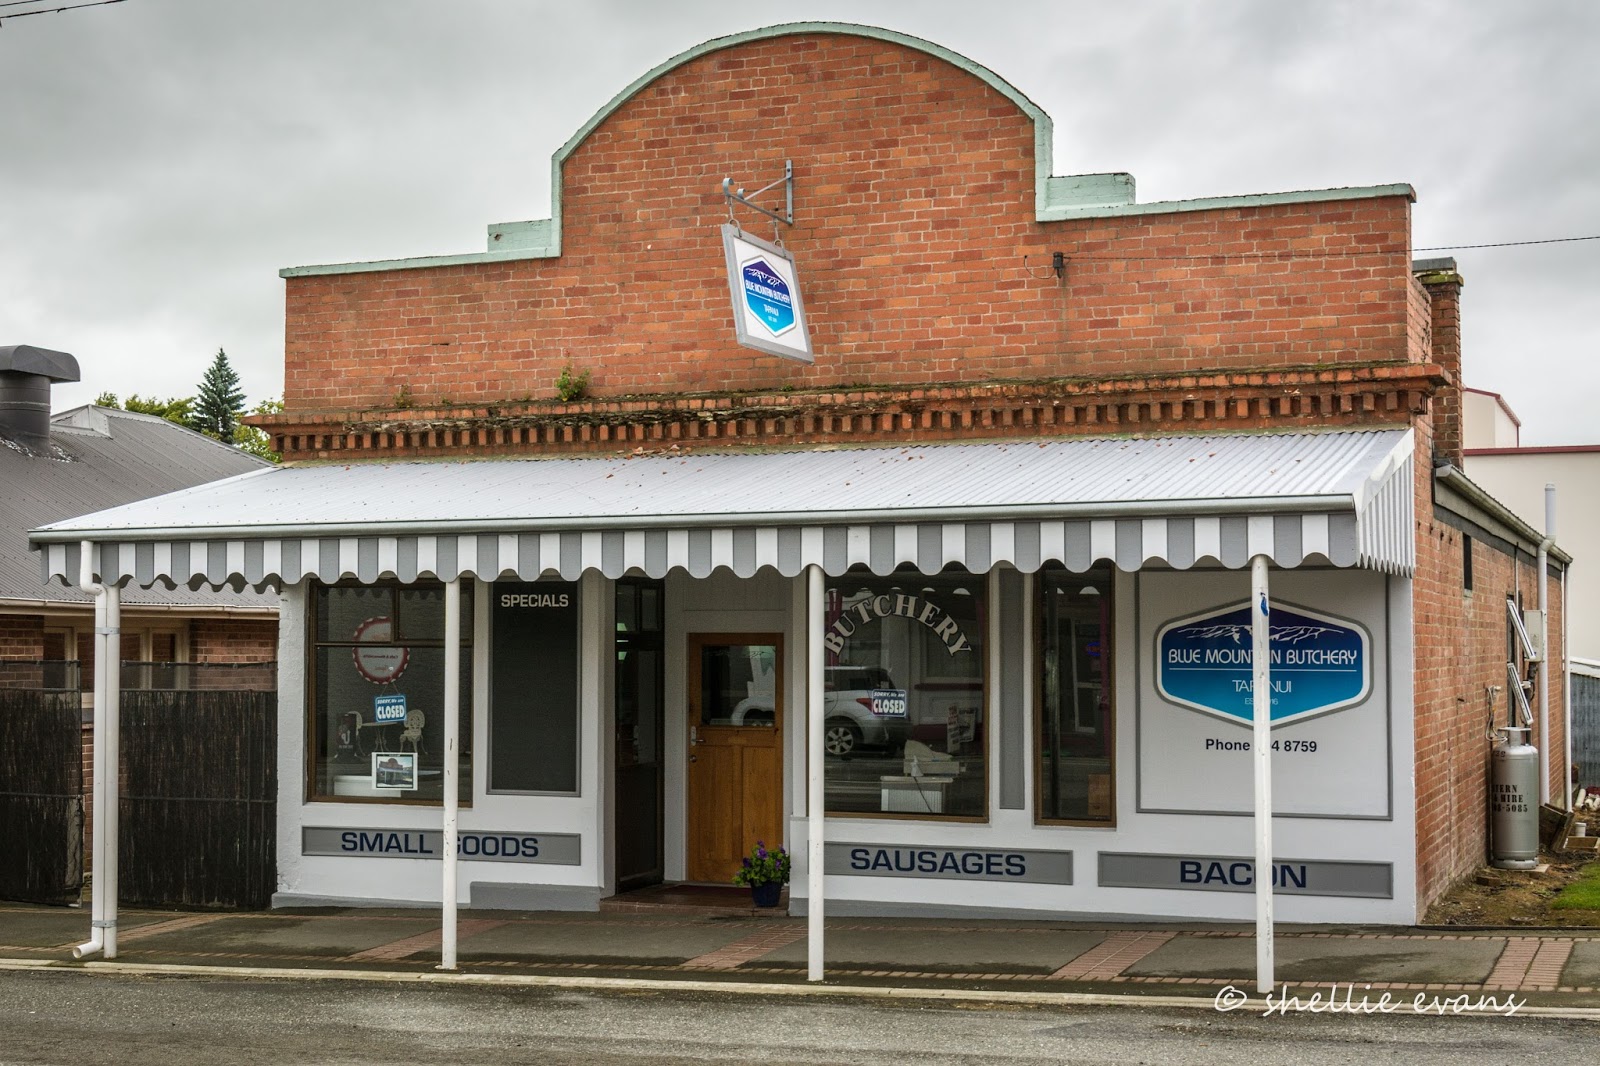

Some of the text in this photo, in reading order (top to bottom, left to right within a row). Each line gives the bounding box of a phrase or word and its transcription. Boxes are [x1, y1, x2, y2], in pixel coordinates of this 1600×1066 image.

[501, 594, 569, 607] SPECIALS
[824, 594, 972, 657] BUTCHERY
[1168, 649, 1357, 665] BLUE MOUNN BUTCHERY
[377, 704, 405, 719] CLOSED
[873, 699, 905, 713] CLOSED
[1205, 738, 1251, 751] Phone
[1284, 740, 1317, 752] 8759
[1500, 794, 1523, 803] HIRE
[341, 832, 539, 857] SMALL OODS
[850, 849, 1026, 876] SAUSAGES
[1180, 861, 1307, 888] BACN
